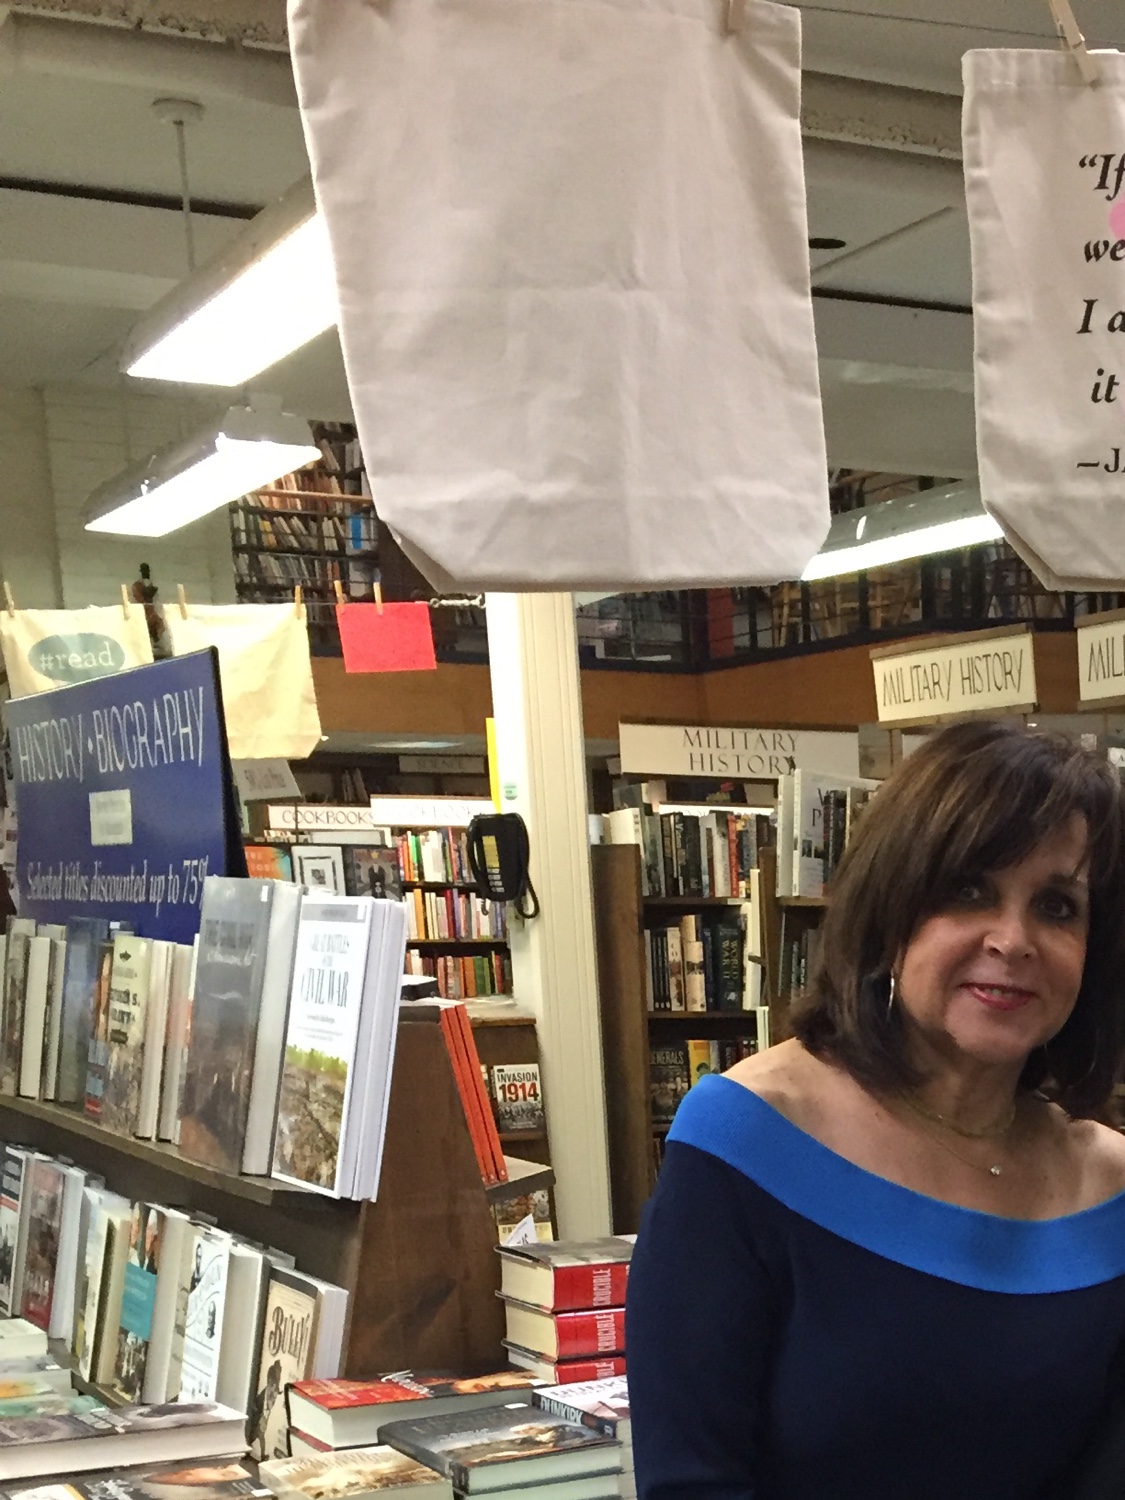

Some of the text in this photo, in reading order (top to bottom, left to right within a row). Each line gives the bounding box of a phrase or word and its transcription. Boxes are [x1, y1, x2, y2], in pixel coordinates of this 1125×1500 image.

[1077, 300, 1098, 334] I
[1091, 368, 1119, 403] it
[40, 641, 114, 670] #read
[883, 649, 1023, 706] MILITARY HISTORY
[16, 686, 204, 782] HISTORY BIOGRAPHY
[682, 729, 799, 752] MILITARY
[690, 753, 796, 773] HISTORY
[27, 861, 62, 900] Selected
[64, 861, 88, 901] titles
[90, 859, 147, 902] discounted
[149, 874, 162, 917] up
[168, 864, 180, 904] to
[182, 855, 208, 910] 75%
[497, 1072, 539, 1083] INVASION
[498, 1082, 540, 1102] 1914
[592, 1268, 612, 1308] CRUCIBLE
[598, 1312, 616, 1352] CRUCIBLE
[540, 1395, 584, 1425] DUNKIRK
